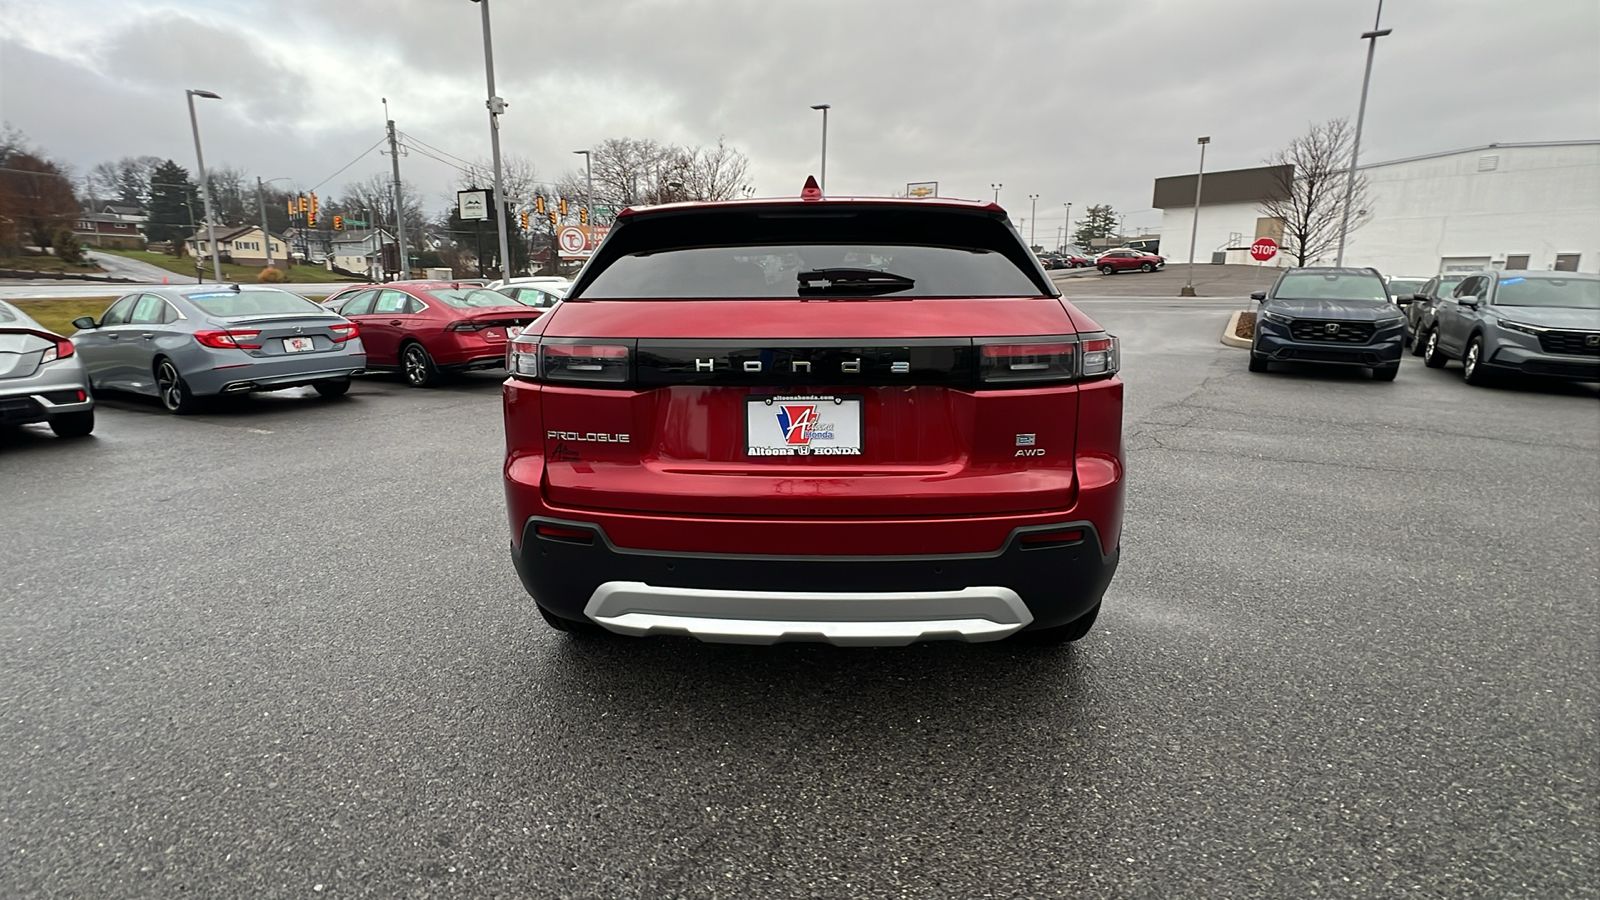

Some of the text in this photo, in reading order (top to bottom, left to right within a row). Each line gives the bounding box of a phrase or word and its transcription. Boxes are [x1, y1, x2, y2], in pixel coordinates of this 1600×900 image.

[1252, 245, 1276, 255] STOP
[547, 430, 630, 443] PROLOGUE
[805, 431, 834, 439] Honda
[748, 447, 794, 456] Altoona
[815, 447, 860, 455] HONDA
[1014, 448, 1046, 457] AWD
